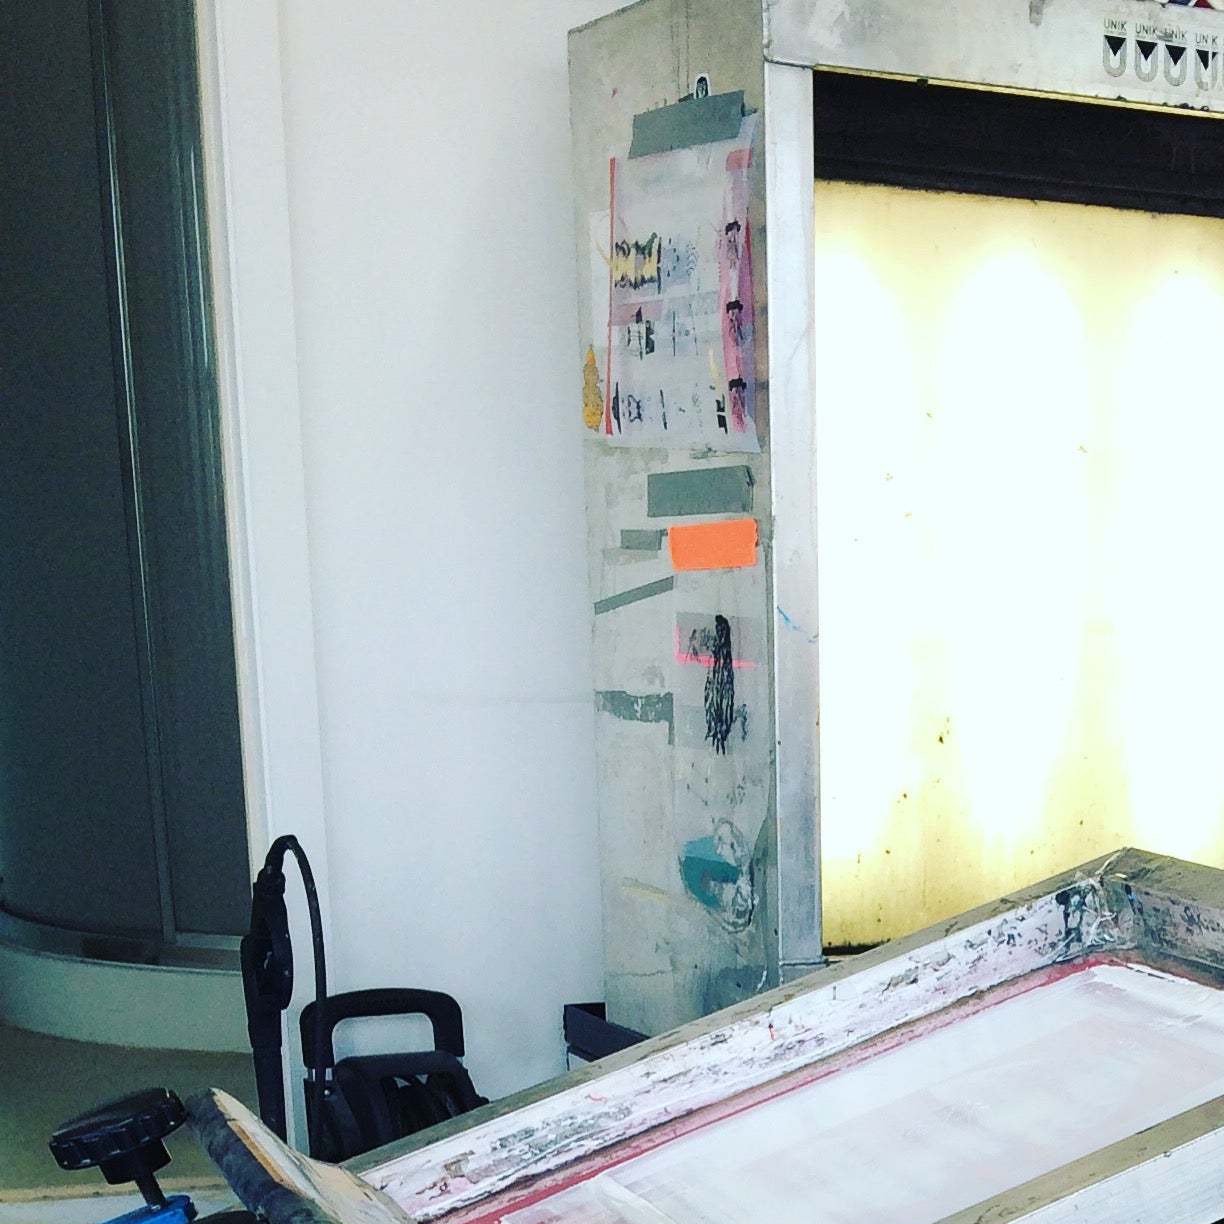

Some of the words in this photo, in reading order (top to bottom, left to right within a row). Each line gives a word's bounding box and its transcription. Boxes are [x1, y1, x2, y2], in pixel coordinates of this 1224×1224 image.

[1103, 18, 1128, 31] UNIK
[1135, 23, 1158, 35] UNIK
[1195, 32, 1218, 46] UNK
